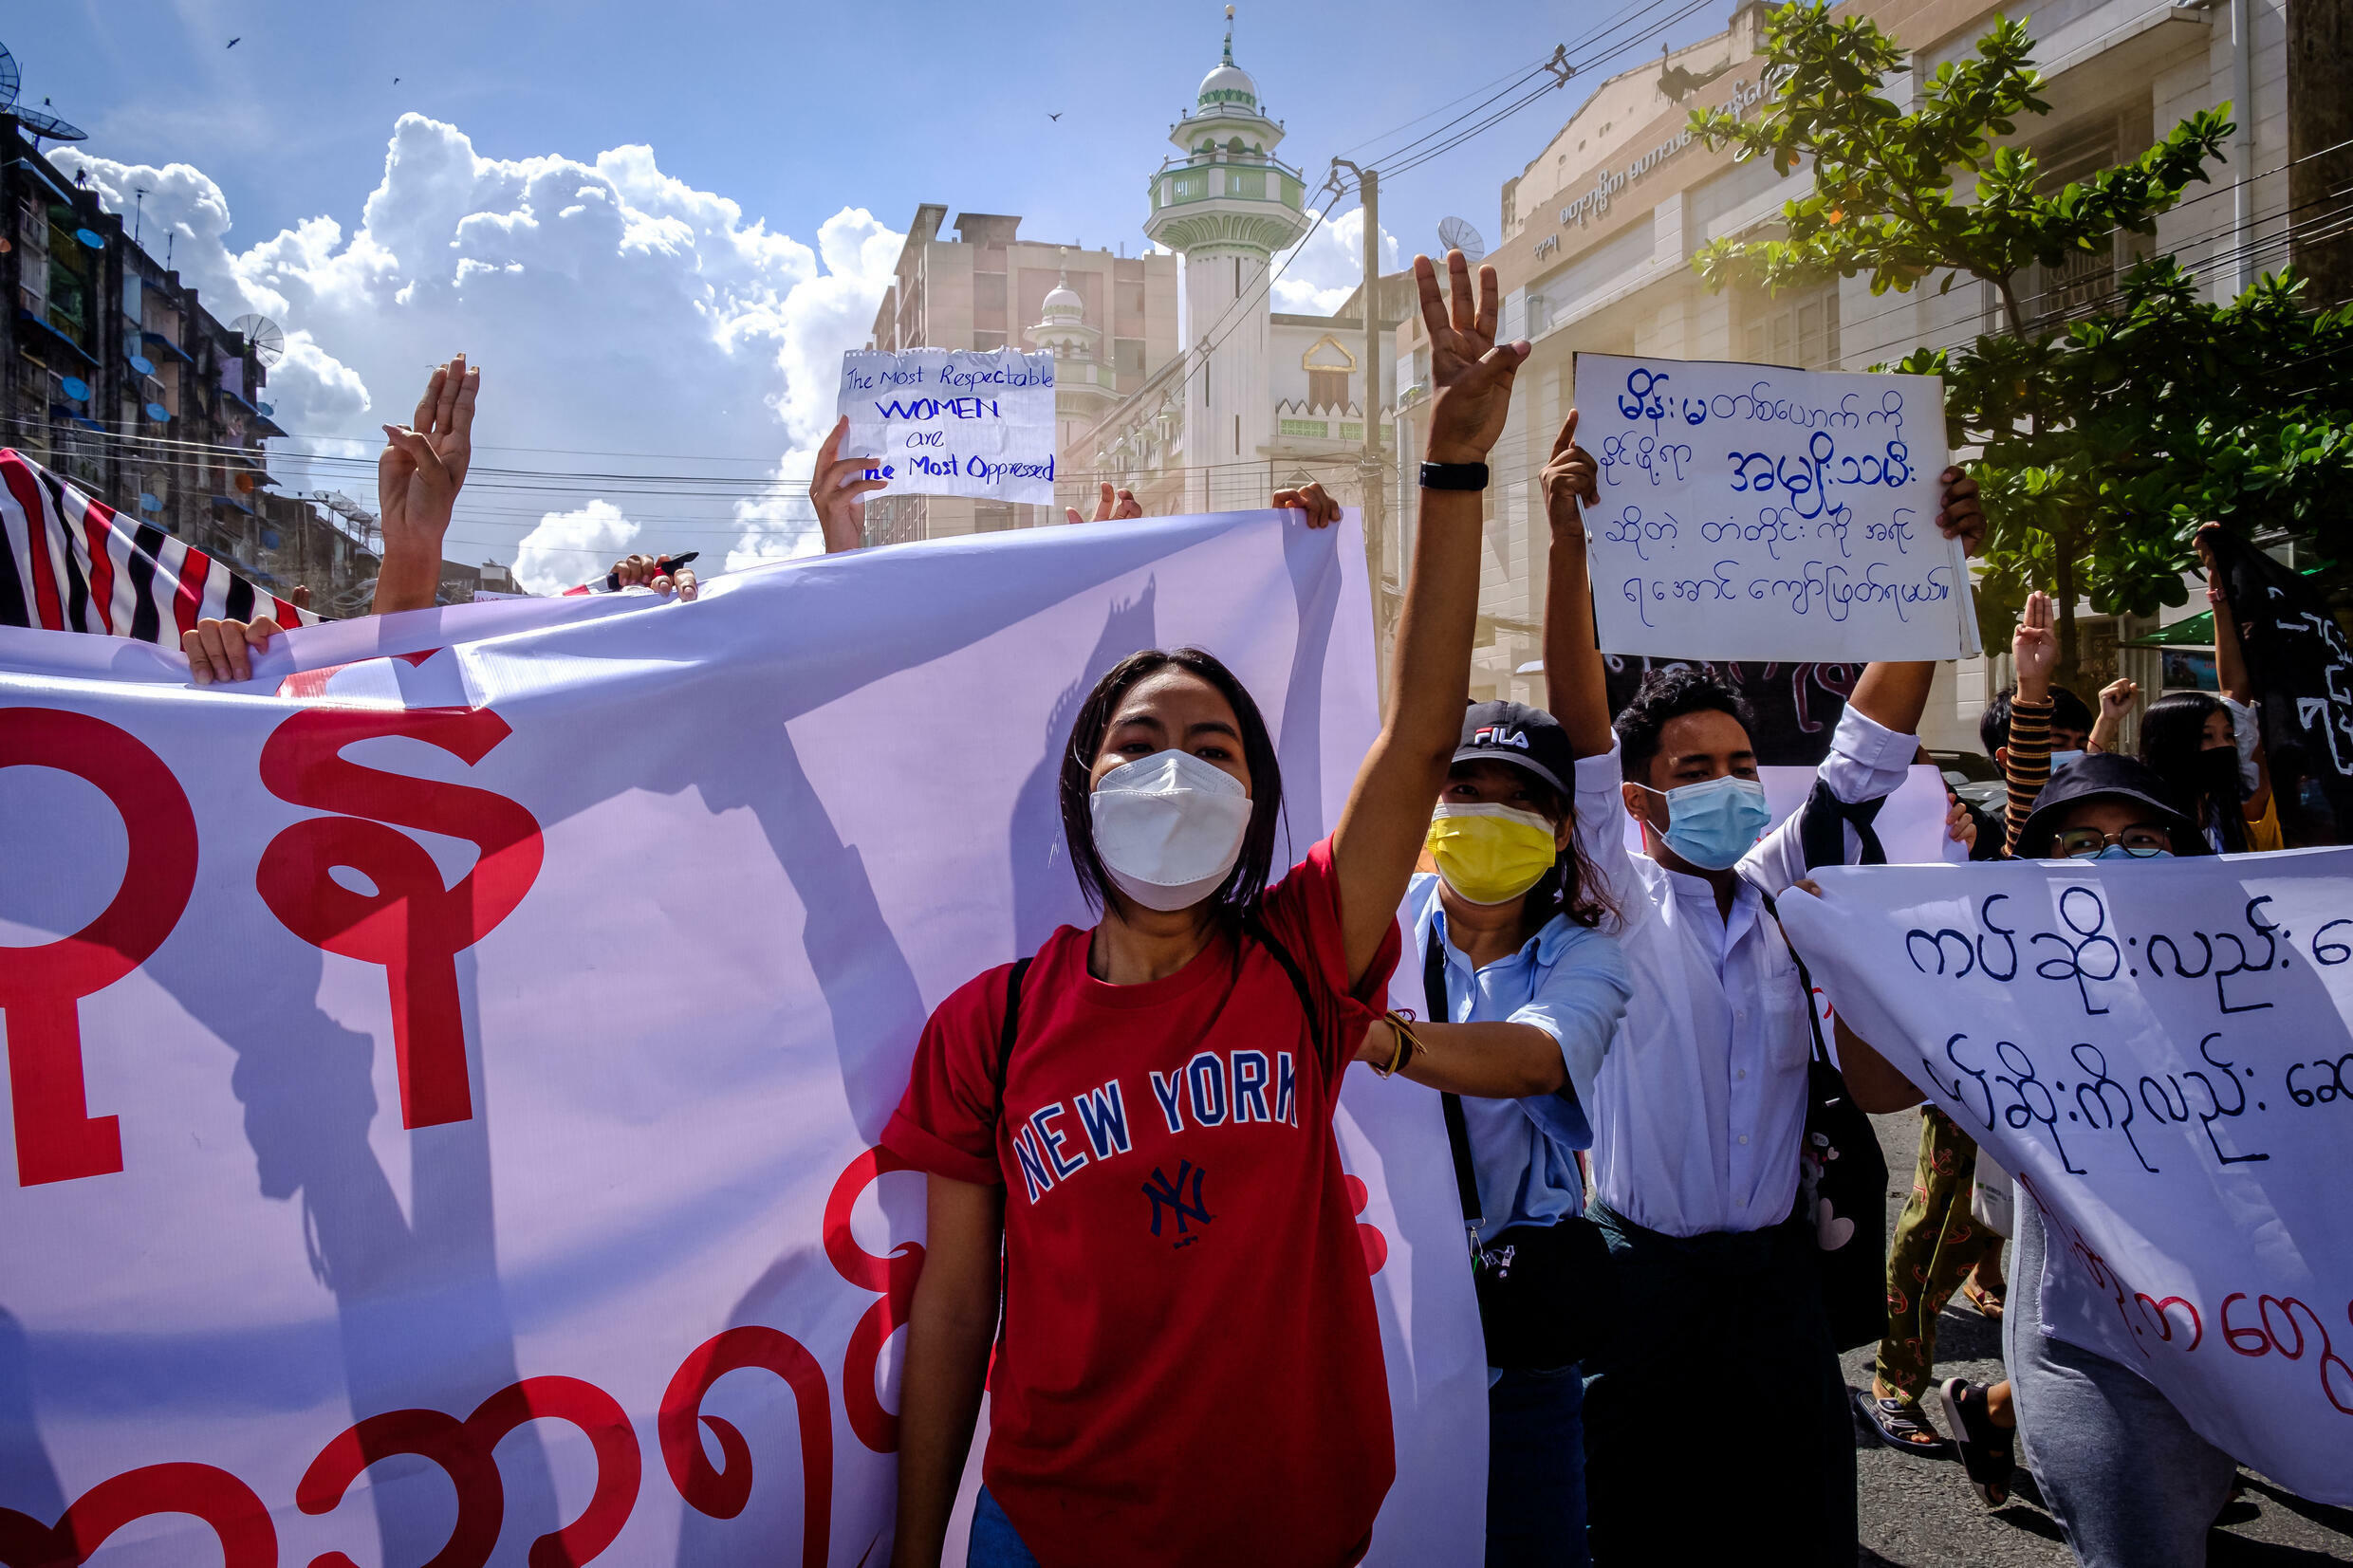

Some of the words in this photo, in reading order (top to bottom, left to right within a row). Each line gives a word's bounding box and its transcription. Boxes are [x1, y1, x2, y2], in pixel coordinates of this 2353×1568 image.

[847, 367, 873, 390] The
[939, 364, 1054, 392] Respectable
[874, 397, 1002, 420] WOMEN
[906, 431, 944, 448] are
[862, 453, 895, 481] he
[909, 453, 959, 477] Most
[966, 453, 1055, 485] Oppressed
[1473, 727, 1529, 749] FILA
[1012, 1078, 1133, 1206] NEW
[1149, 1049, 1299, 1134] YORK
